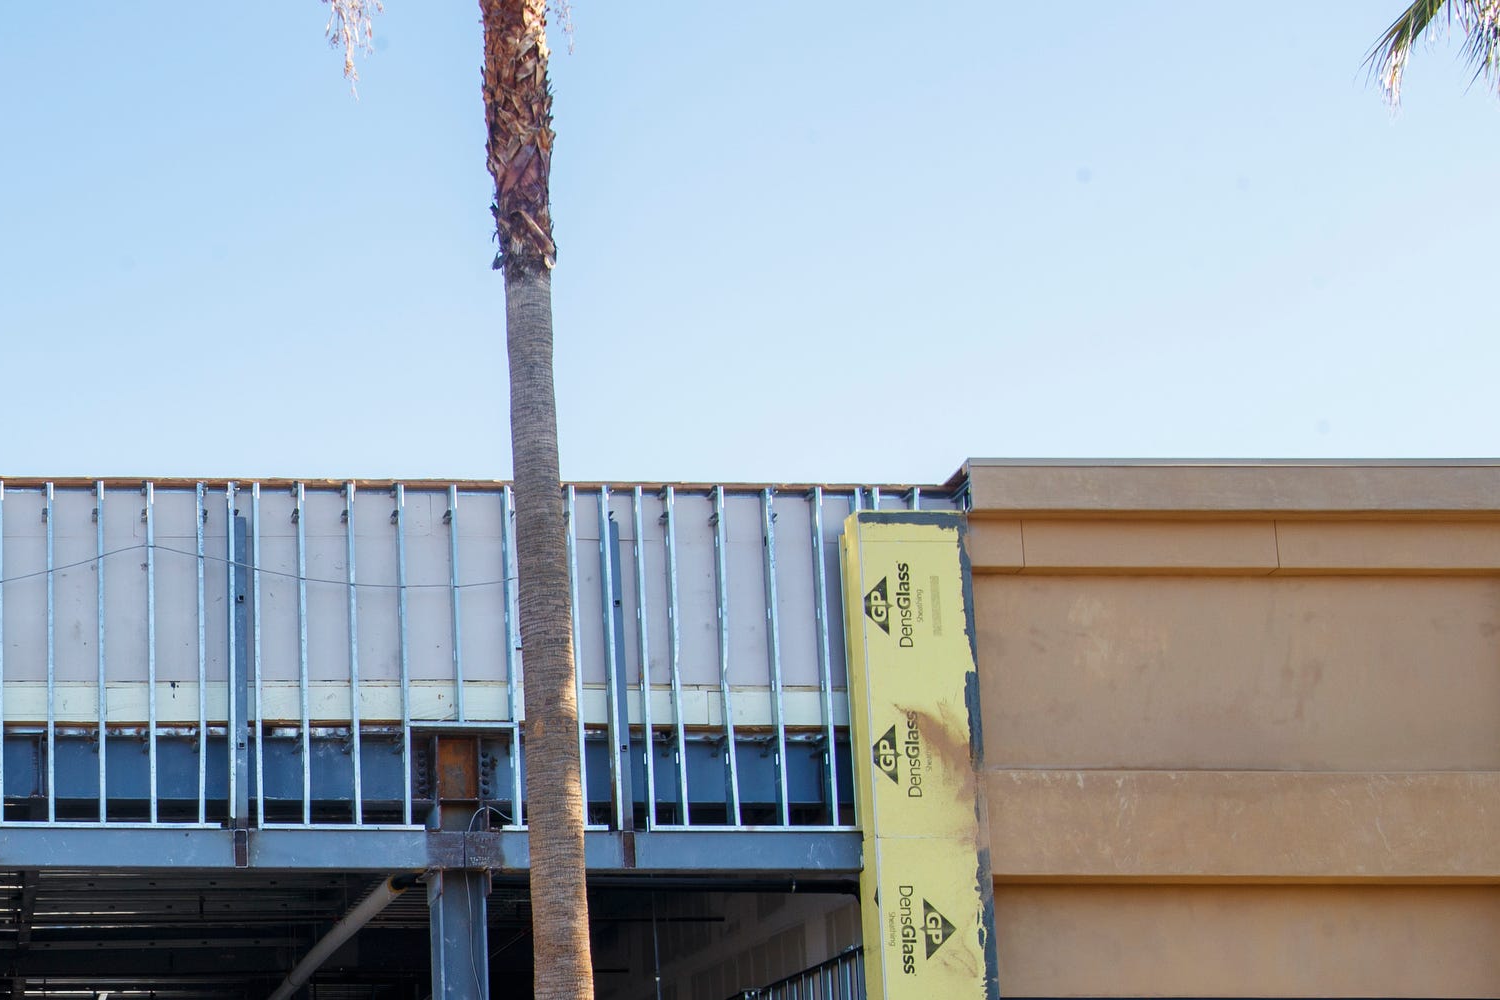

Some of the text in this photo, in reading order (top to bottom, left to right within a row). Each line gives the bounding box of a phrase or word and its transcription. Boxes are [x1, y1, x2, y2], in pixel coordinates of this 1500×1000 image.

[871, 590, 888, 622] GP
[897, 562, 913, 648] DensGlass
[916, 588, 924, 623] Sheathing
[879, 739, 896, 772] GP
[904, 710, 922, 798] DensGlass
[888, 912, 896, 947] Sheathing
[899, 885, 916, 975] DensGlass
[925, 911, 943, 945] GP
